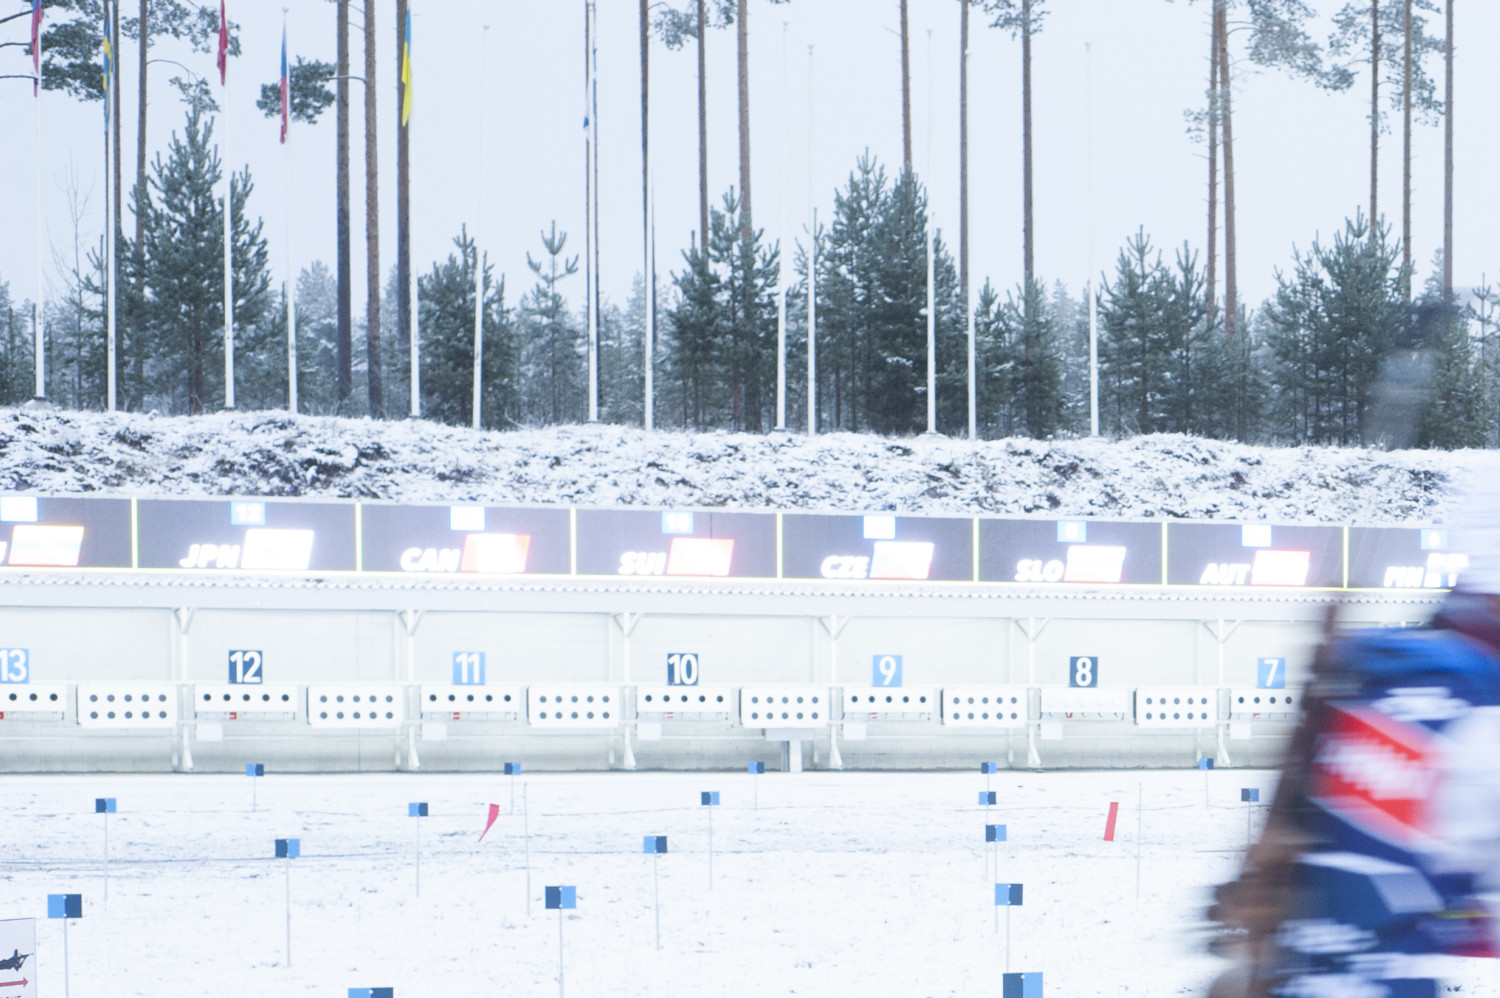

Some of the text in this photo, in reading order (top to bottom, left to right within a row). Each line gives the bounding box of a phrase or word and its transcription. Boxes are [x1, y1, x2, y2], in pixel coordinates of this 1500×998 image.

[180, 544, 241, 568] JPN
[401, 548, 460, 572] CAN
[618, 551, 667, 576] SUI
[821, 556, 869, 579] CZE
[1015, 560, 1065, 582] SLO
[1200, 563, 1251, 585] AUT
[1384, 567, 1425, 588] FIN
[0, 649, 28, 683] 13
[230, 651, 262, 684] 12
[455, 653, 482, 684] 11
[668, 654, 698, 685] 10
[878, 656, 896, 686] 9
[1075, 657, 1093, 687] 8
[1263, 659, 1280, 687] 7
